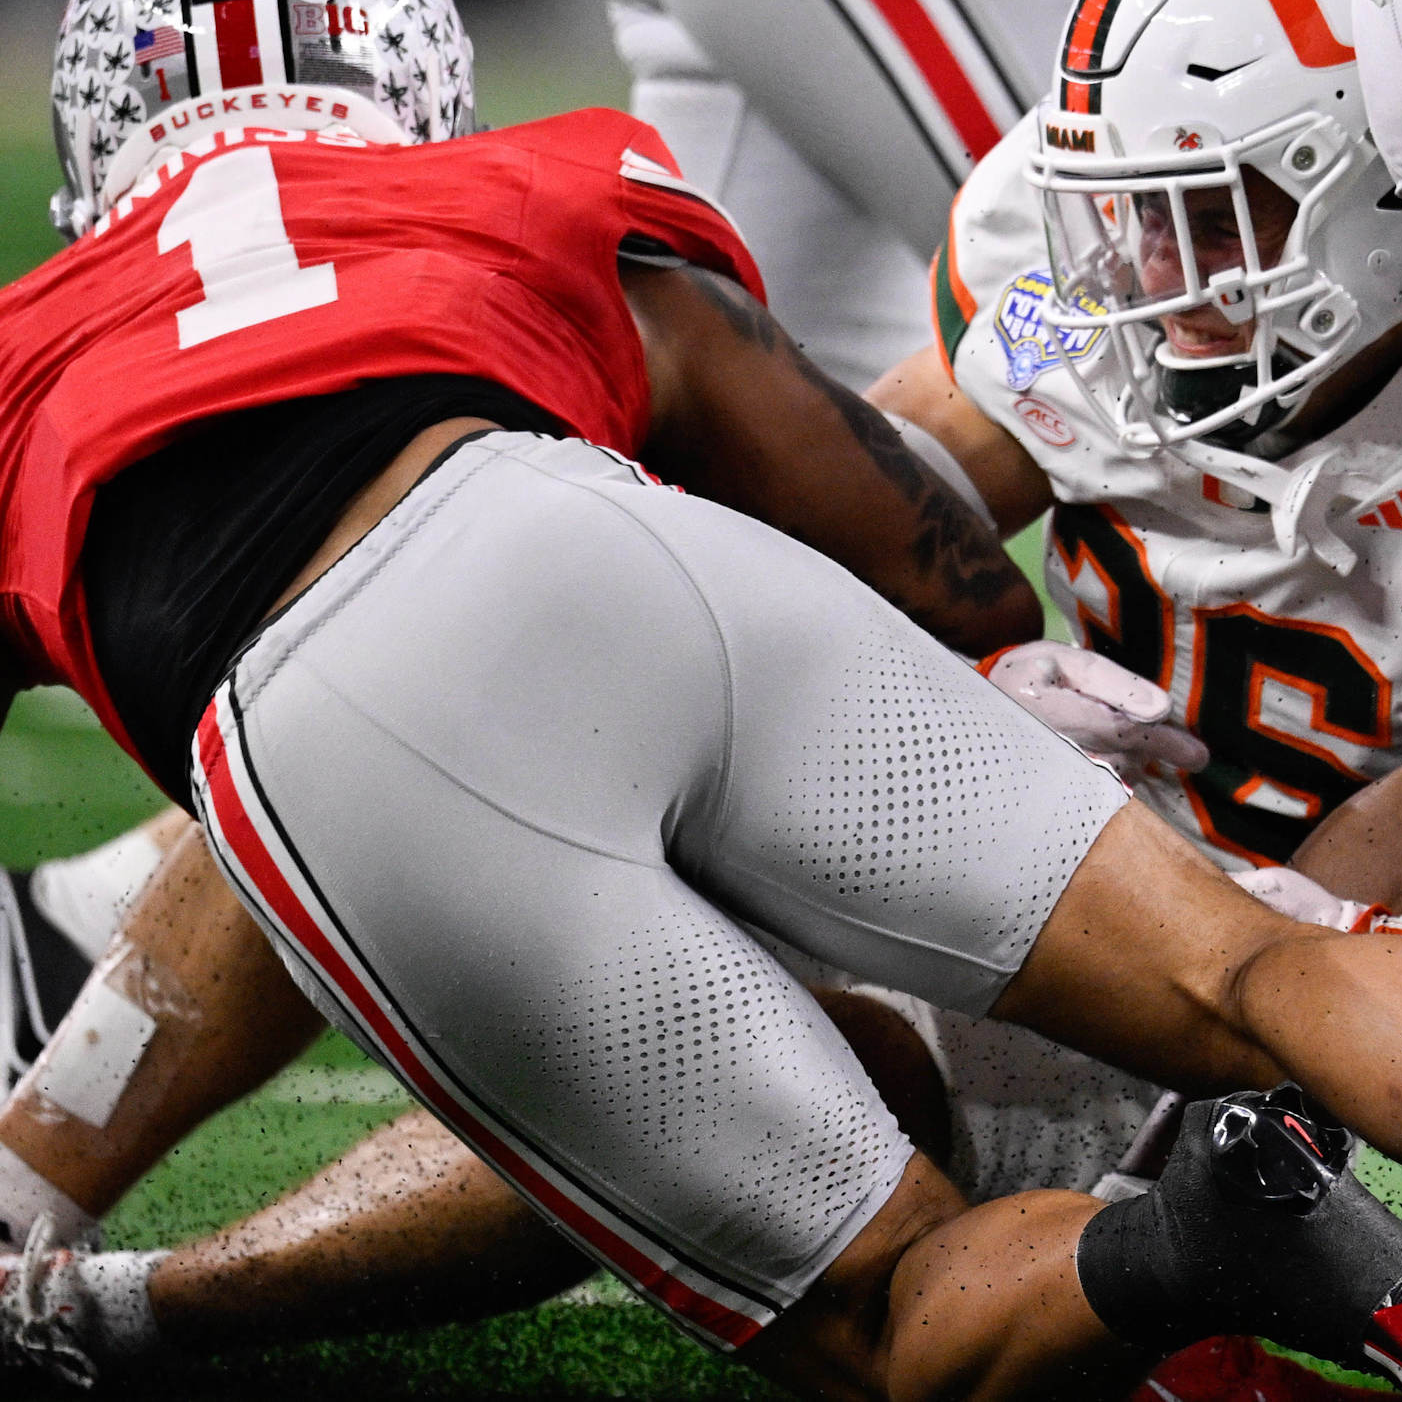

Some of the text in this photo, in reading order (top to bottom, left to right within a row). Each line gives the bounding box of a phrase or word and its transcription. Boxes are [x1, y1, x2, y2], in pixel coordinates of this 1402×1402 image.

[155, 69, 171, 102] 1
[150, 93, 349, 143] BUCKEYES
[1046, 123, 1096, 153] MIAMI
[157, 146, 338, 350] 1
[1023, 408, 1066, 436] ACC
